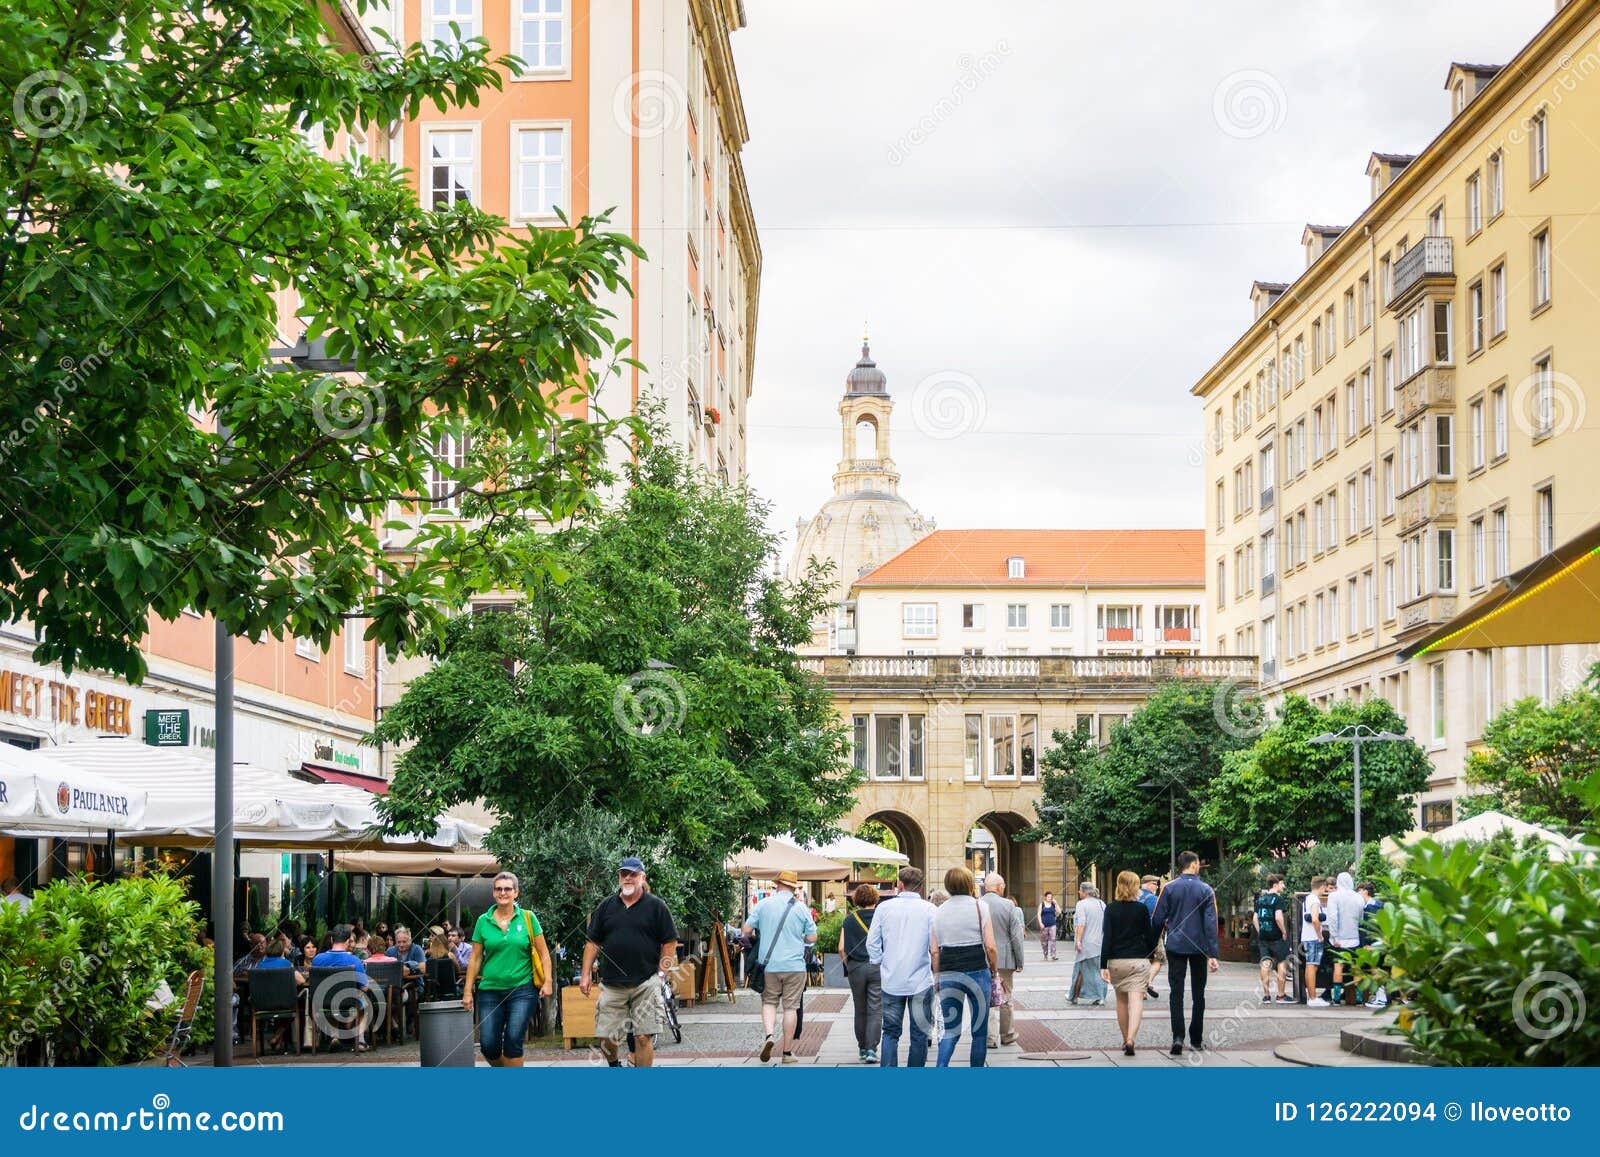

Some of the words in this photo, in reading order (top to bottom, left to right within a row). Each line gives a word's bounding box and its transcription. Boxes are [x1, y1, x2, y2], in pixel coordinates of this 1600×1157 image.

[0, 670, 43, 719] MEET
[49, 681, 80, 725] THE
[85, 689, 131, 736] GREEK
[158, 715, 181, 723] MEET
[158, 723, 181, 733] THE
[73, 788, 128, 816] PAULANER
